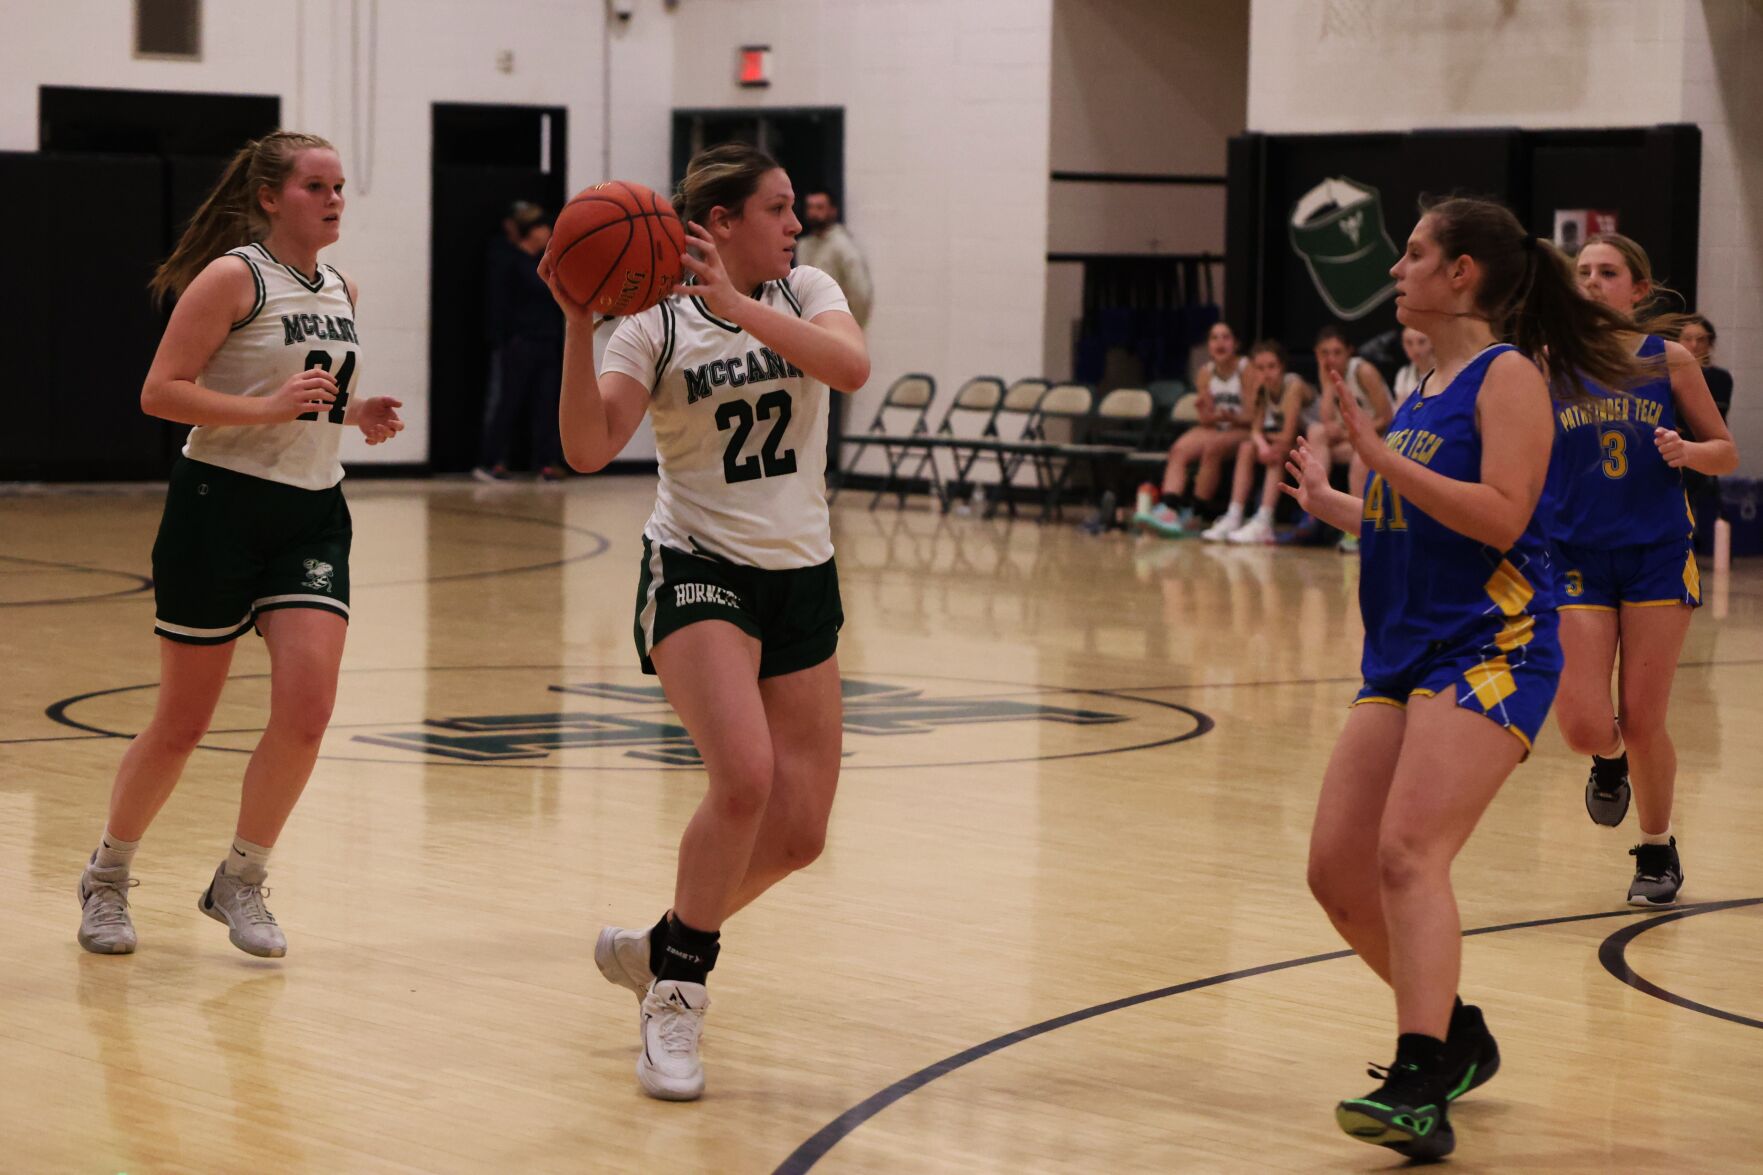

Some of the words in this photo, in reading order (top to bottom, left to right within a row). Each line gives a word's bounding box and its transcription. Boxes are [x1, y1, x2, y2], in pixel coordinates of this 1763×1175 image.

[714, 389, 798, 484] 22
[1635, 398, 1664, 426] TECH
[1601, 429, 1629, 480] 3
[1362, 472, 1409, 532] 41
[1565, 569, 1584, 597] 3
